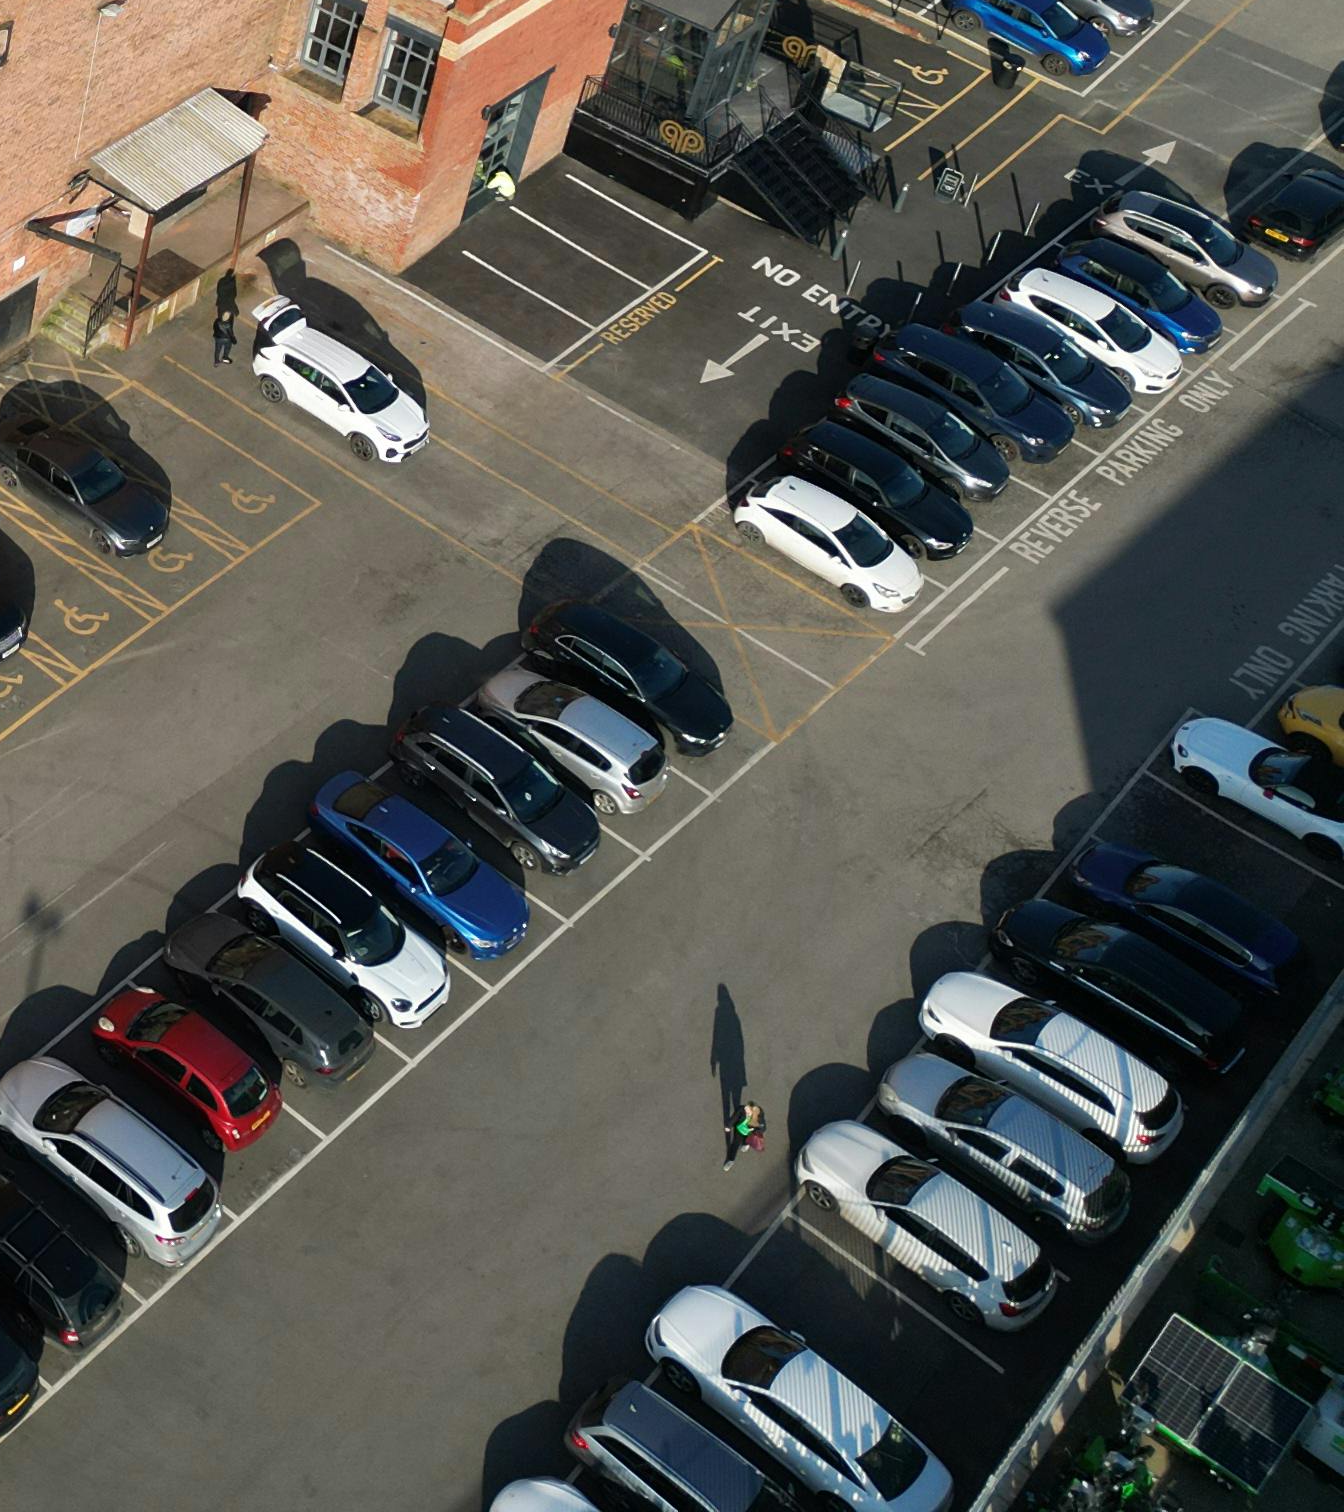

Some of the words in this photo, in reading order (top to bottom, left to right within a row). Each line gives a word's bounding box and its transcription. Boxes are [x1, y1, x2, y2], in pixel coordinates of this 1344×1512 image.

[600, 291, 678, 346] RESERVED
[752, 256, 801, 287] NO
[801, 284, 892, 339] ENTRY
[737, 305, 822, 354] EXIT
[1009, 488, 1103, 565] REVERSE
[1097, 417, 1184, 488] PARKING
[1178, 370, 1235, 414] ONLY
[1229, 645, 1294, 701] ONLY
